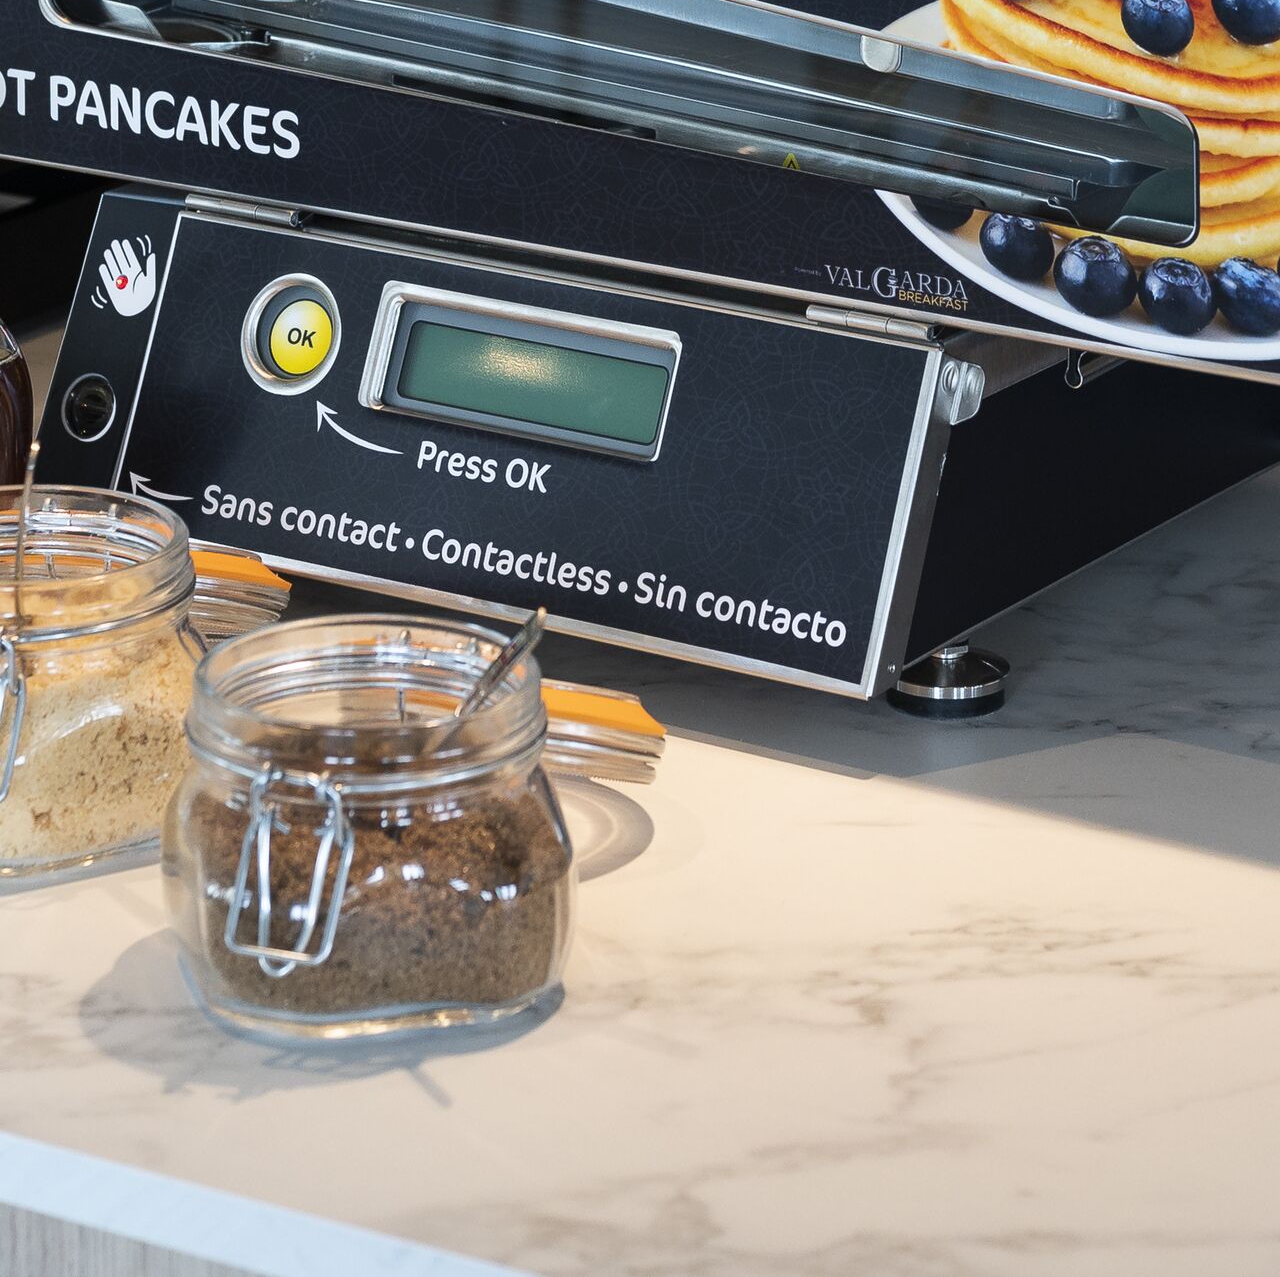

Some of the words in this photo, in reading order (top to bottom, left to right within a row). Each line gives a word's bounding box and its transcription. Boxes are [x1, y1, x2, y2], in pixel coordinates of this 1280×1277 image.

[49, 74, 301, 159] PANCAKES
[824, 264, 969, 300] VALGARDA
[898, 289, 969, 312] BREAKFAST
[287, 327, 317, 348] OK
[416, 440, 498, 484] Press
[504, 457, 552, 494] OK
[201, 484, 274, 526] Sans
[279, 505, 402, 553] contact
[421, 528, 612, 596] Contactless
[634, 571, 688, 613] Sin
[694, 590, 847, 648] contacto
